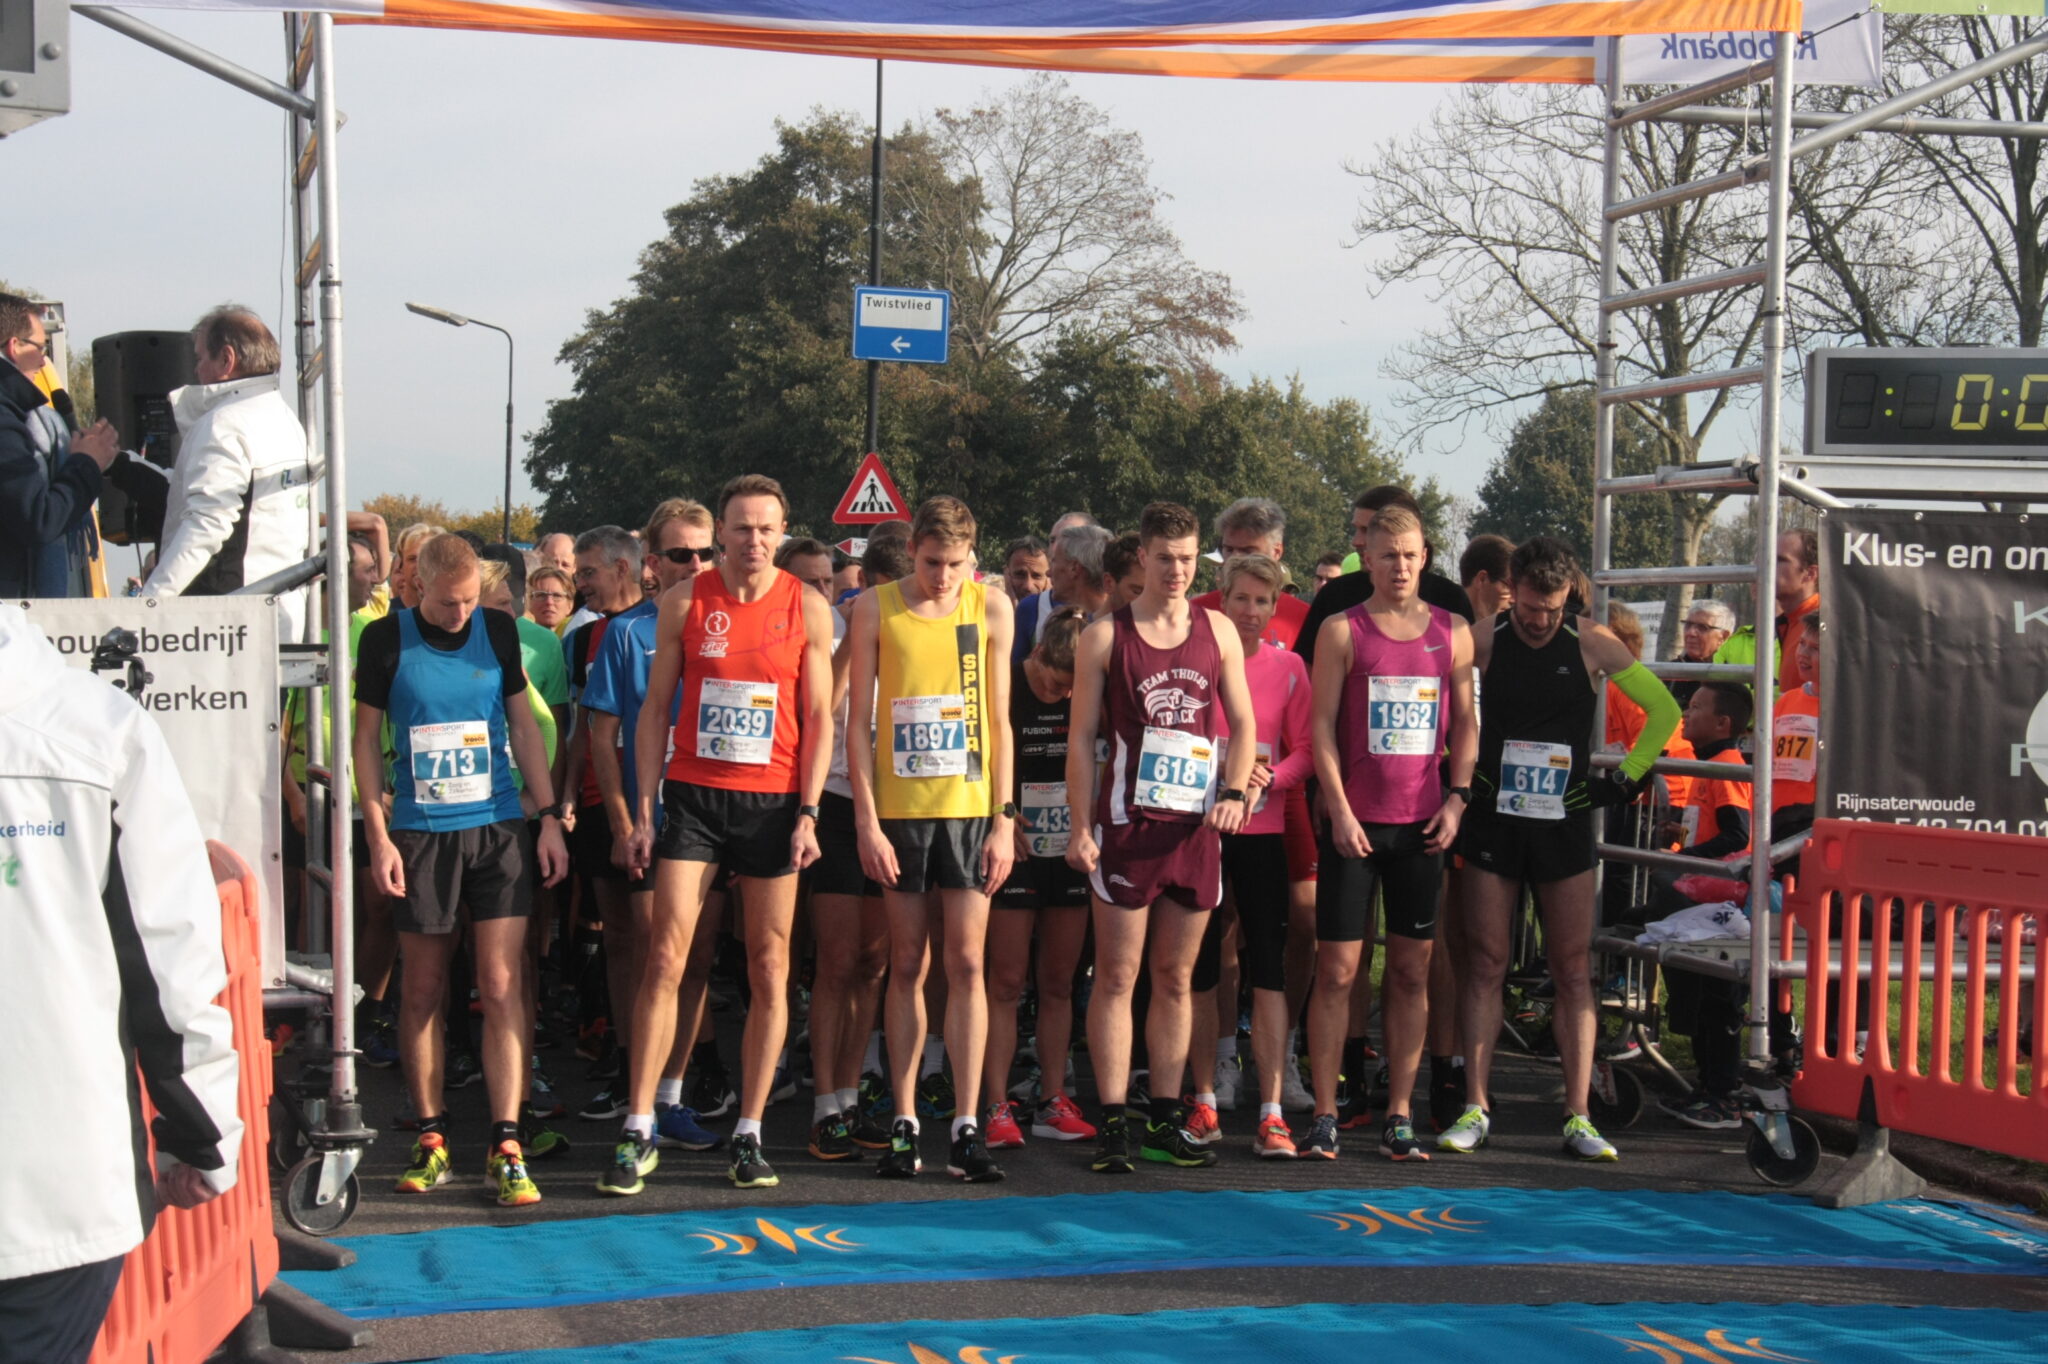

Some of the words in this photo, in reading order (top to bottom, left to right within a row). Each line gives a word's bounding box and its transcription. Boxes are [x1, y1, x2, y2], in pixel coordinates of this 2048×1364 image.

[865, 296, 932, 311] Twistvlied
[1843, 532, 1937, 568] Klus-
[1947, 544, 1992, 569] en
[711, 681, 756, 690] INTERSPORT
[1137, 670, 1169, 694] TEAM
[1171, 668, 1208, 690] THUIJS
[898, 697, 942, 706] INTERSPORT
[962, 653, 979, 752] SPARTA
[706, 706, 767, 736] 2039
[1157, 709, 1196, 726] TRACK
[1378, 702, 1432, 729] 1962
[901, 722, 958, 750] 1897
[428, 749, 475, 778] 713
[1154, 755, 1197, 786] 618
[1515, 766, 1556, 794] 614
[1836, 793, 1976, 813] Rijnsaterwoude
